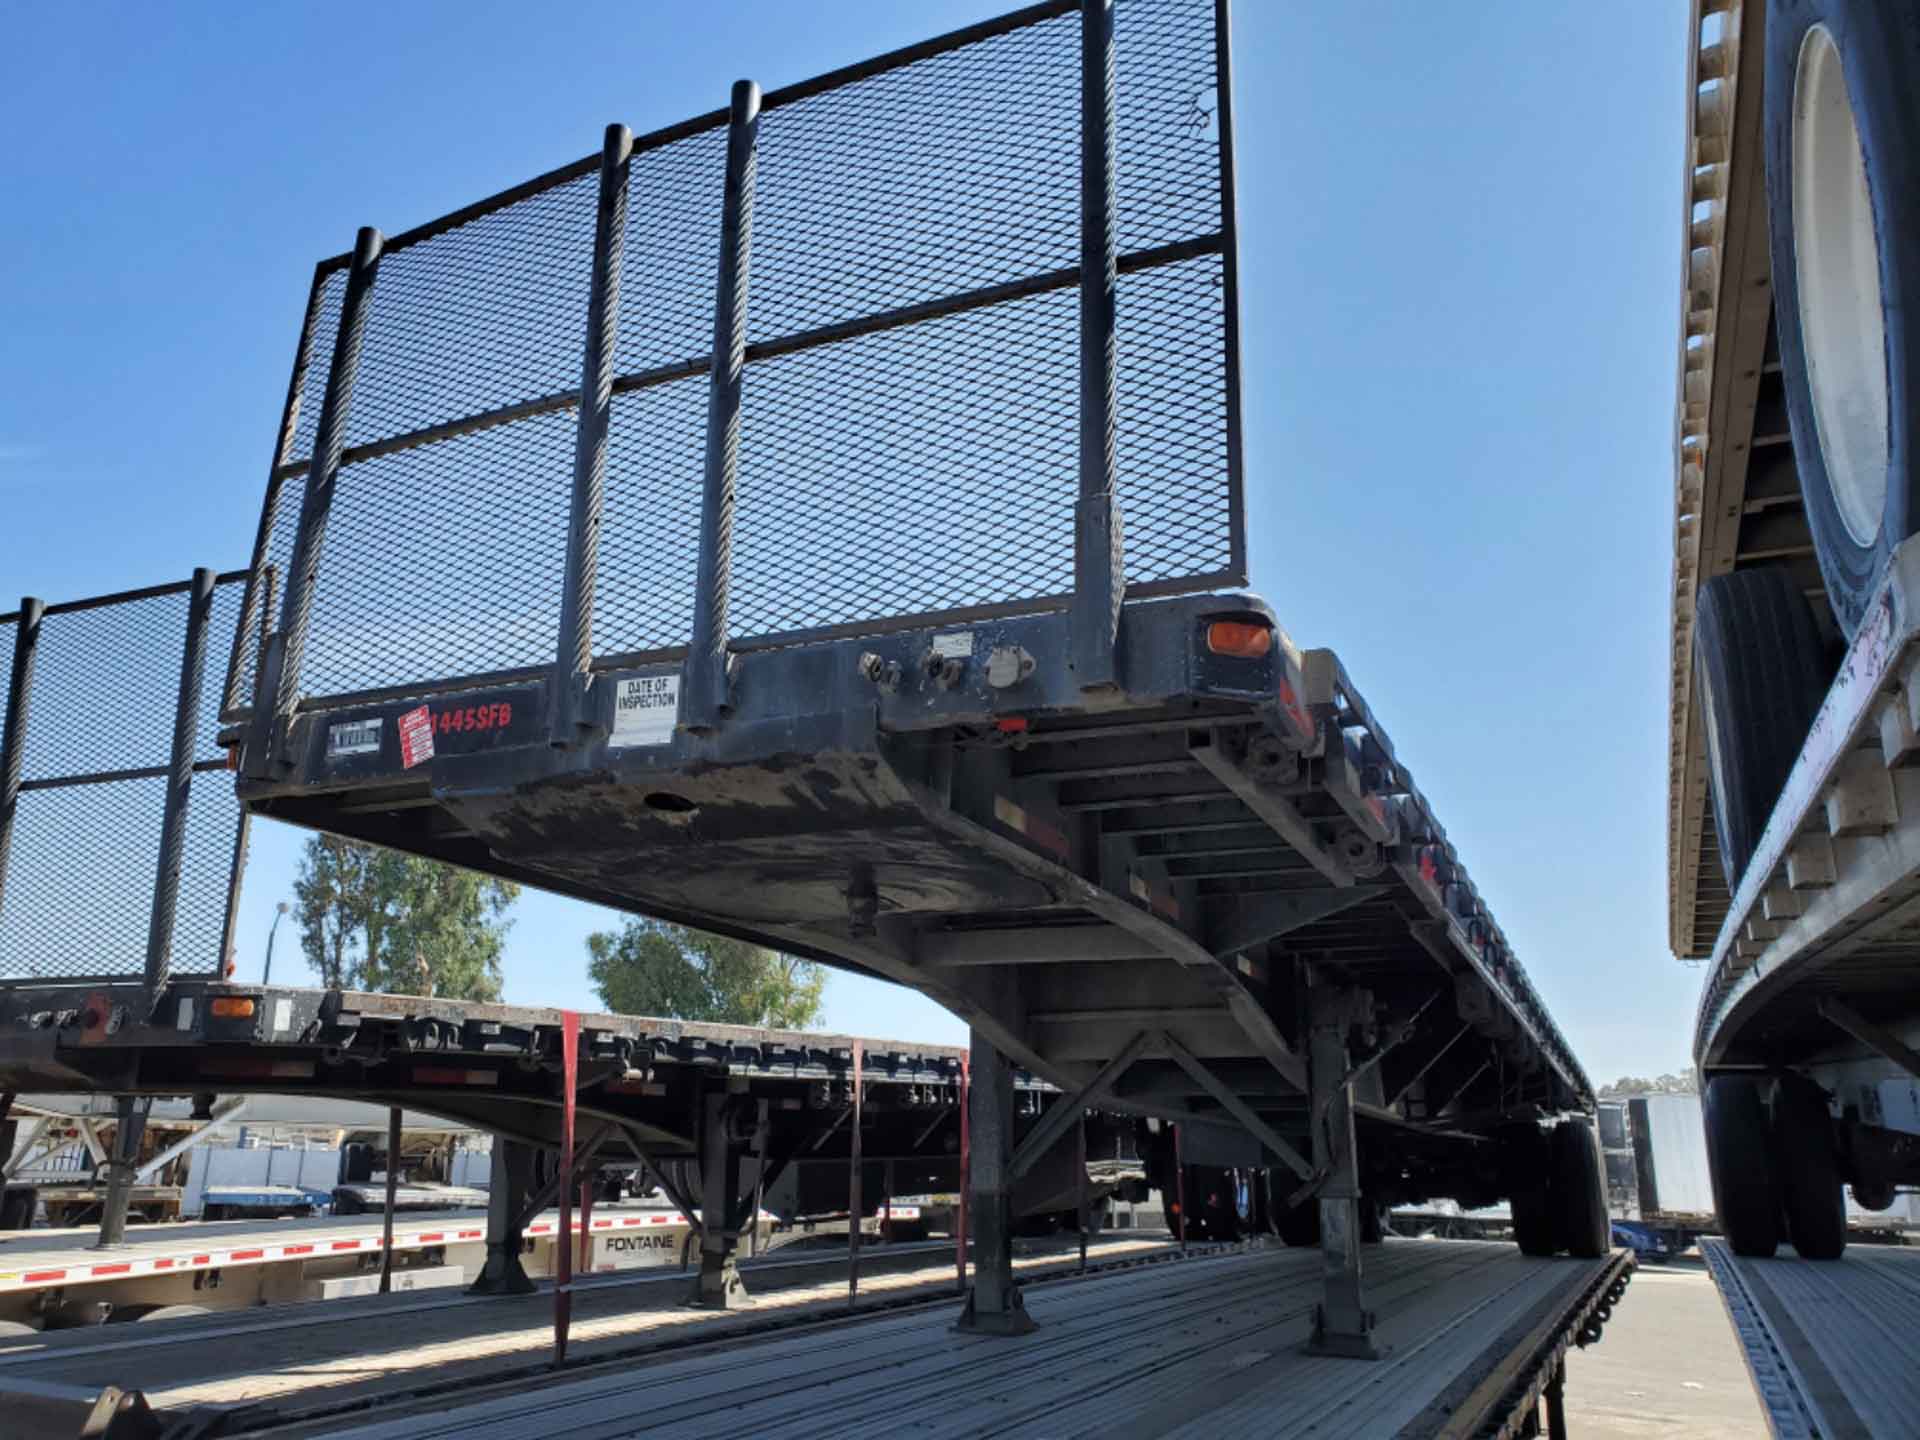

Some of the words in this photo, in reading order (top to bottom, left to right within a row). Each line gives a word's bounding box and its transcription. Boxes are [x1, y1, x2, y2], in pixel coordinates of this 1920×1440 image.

[628, 679, 654, 694] DATE
[655, 678, 669, 692] OF
[618, 692, 676, 710] INSPECTION
[606, 1234, 673, 1251] FONTAINE
